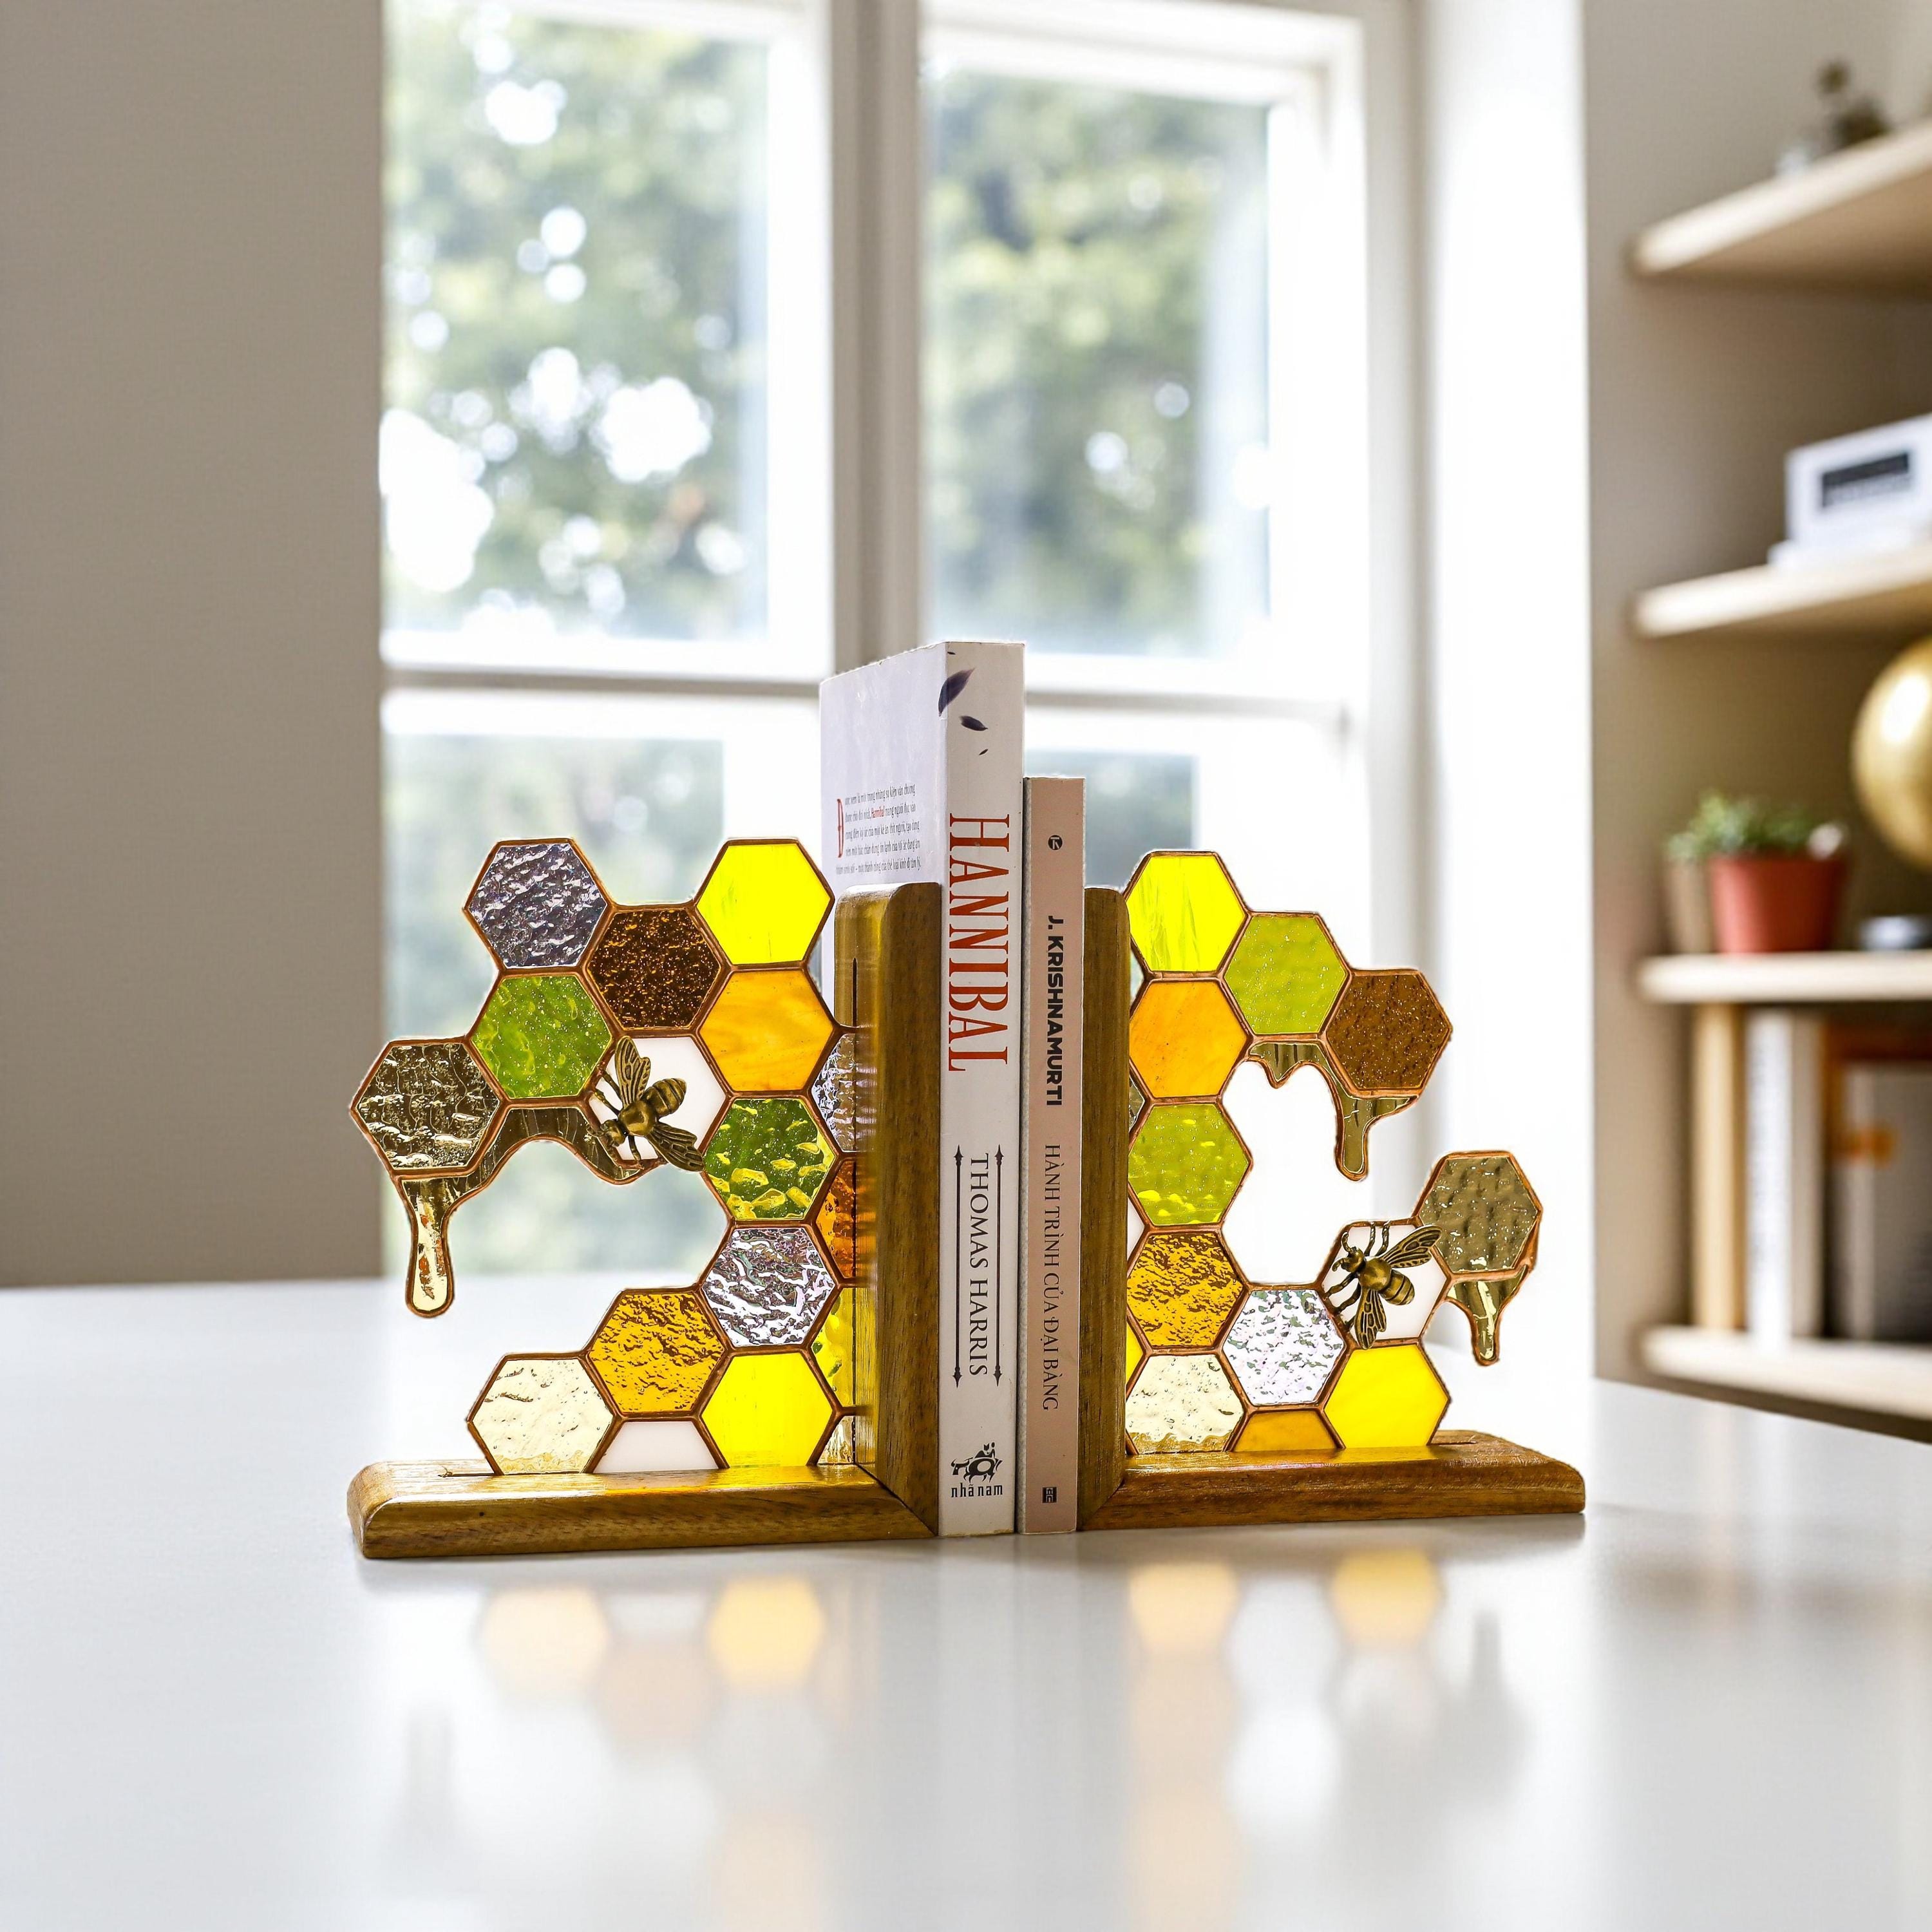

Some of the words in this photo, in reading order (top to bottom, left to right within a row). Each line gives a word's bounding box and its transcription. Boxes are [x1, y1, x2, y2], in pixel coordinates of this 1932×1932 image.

[949, 813, 1009, 1071] HANNIBAL
[1048, 915, 1064, 930] J.
[1046, 936, 1064, 1106] KRISHNAMURTI
[1045, 1145, 1065, 1201] HÀNH
[970, 1153, 989, 1269] THOMAS
[1044, 1206, 1065, 1267] TRÌNH
[1043, 1273, 1064, 1314] CỦA
[969, 1278, 988, 1376] HARRIS
[1040, 1316, 1059, 1352] ĐẠI
[1042, 1358, 1063, 1410] BÀNG
[951, 1482, 974, 1497] nhã
[978, 1485, 1003, 1496] nam
